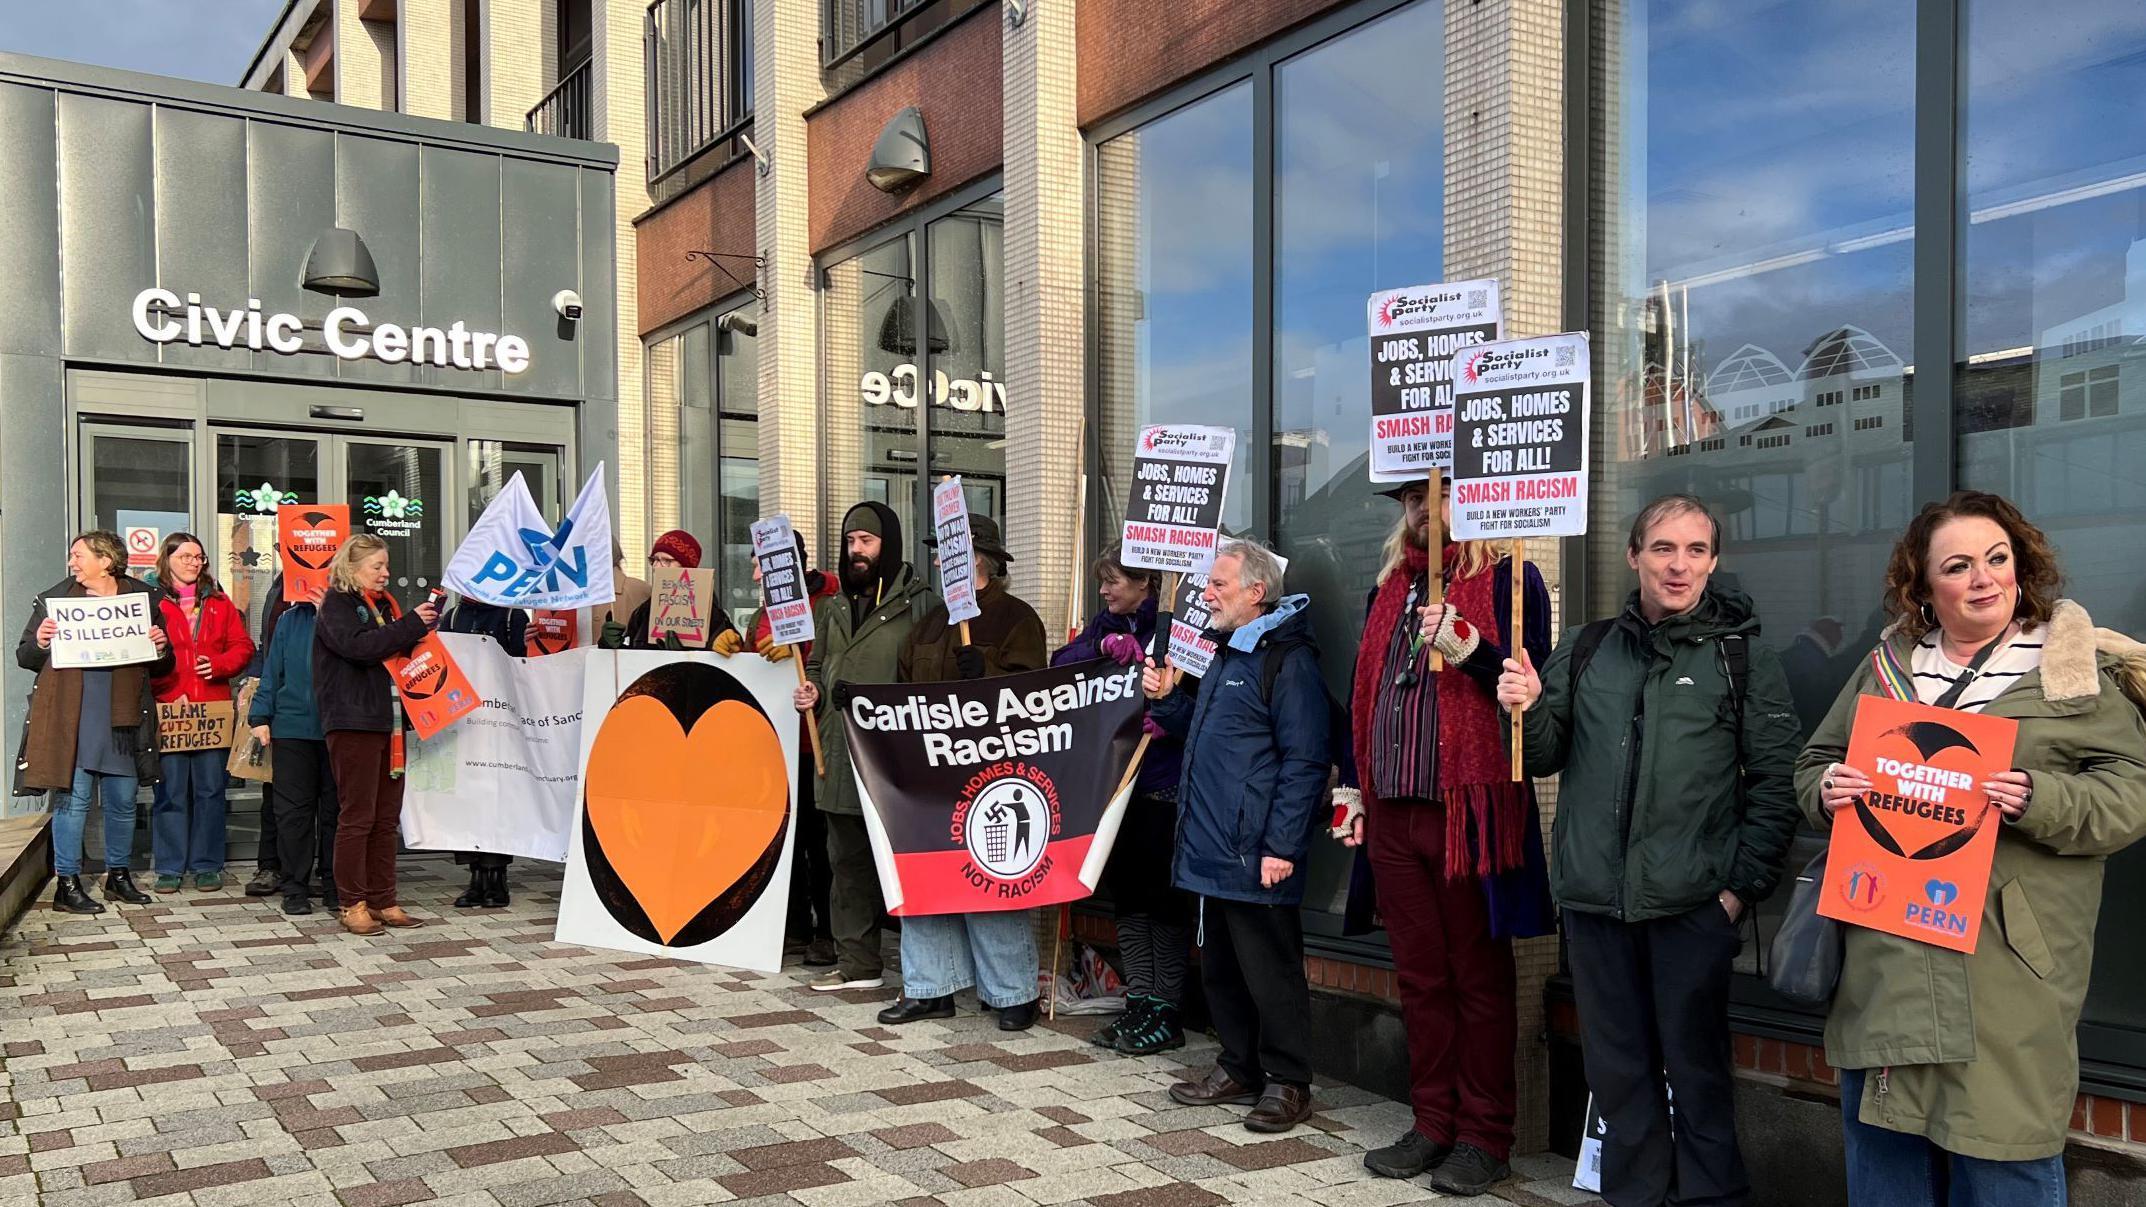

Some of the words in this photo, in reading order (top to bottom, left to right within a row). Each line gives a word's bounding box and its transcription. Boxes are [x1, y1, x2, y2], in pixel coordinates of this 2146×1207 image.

[1396, 293, 1462, 307] Socialist
[133, 287, 303, 352] Civic
[323, 307, 529, 374] Centre
[1378, 338, 1423, 362] JOBS,
[1482, 348, 1549, 363] Socialist
[1389, 367, 1401, 386] &
[1405, 359, 1455, 385] SERVIC
[1401, 387, 1431, 410] FOR
[1435, 384, 1452, 406] AL
[1461, 396, 1507, 422] JOBS,
[1511, 390, 1571, 418] HOMES
[1160, 430, 1207, 441] Socialist
[1377, 416, 1430, 439] SMASH
[1471, 427, 1483, 448] &
[1487, 418, 1563, 447] SERVICES
[1388, 444, 1405, 453] BUILD
[1407, 443, 1411, 452] A
[1413, 442, 1428, 451] NEW
[1430, 440, 1451, 450] WORKE
[1402, 453, 1419, 462] FIGHT
[1422, 452, 1434, 460] FOR
[1482, 450, 1513, 474] FOR
[1516, 446, 1551, 471] ALL!
[1138, 462, 1171, 483] JOBS,
[1174, 465, 1217, 485] HOMES
[1143, 485, 1152, 500] &
[1154, 484, 1209, 505] SERVICES
[1457, 480, 1510, 504] SMASH
[1516, 477, 1577, 501] RACISM
[366, 518, 421, 529] Cumberland
[1147, 503, 1170, 522] FOR
[1171, 505, 1198, 524] ALL!
[1466, 510, 1484, 521] BUILD
[1486, 510, 1490, 519] A
[1492, 509, 1507, 519] NEW
[1544, 506, 1566, 516] PARTY
[292, 529, 337, 538] TOGETHER
[377, 528, 411, 537] Council
[1480, 520, 1498, 530] FIGHT
[1500, 520, 1512, 529] FOR
[1514, 518, 1551, 529] SOCIALISM
[303, 537, 327, 545] WITH
[1126, 525, 1166, 544] SMASH
[1169, 529, 1214, 548] RACISM
[294, 544, 337, 552] REFUGEES
[1150, 548, 1161, 556] NEW
[1188, 551, 1204, 560] PARTY
[1155, 557, 1165, 565] FOR
[1165, 558, 1192, 567] SOCIALISM
[1187, 572, 1209, 589] JOB
[1185, 590, 1196, 604] &
[56, 603, 143, 622] NO-ONE
[655, 616, 664, 626] ON
[666, 617, 680, 627] OUR
[1184, 607, 1207, 627] FOR
[58, 628, 72, 641] IS
[77, 624, 146, 640] ILLEGAL
[1170, 623, 1196, 645] MASH
[405, 663, 441, 690] REFUGEES
[852, 694, 989, 732] Carlisle
[995, 665, 1139, 725] Against
[162, 703, 207, 719] BLAME
[159, 720, 192, 733] CUTS
[197, 717, 225, 731] NOT
[520, 716, 535, 727] ace
[538, 716, 550, 727] of
[160, 731, 222, 749] REFUGEES
[922, 722, 1073, 767] Racism
[1876, 757, 1973, 791] TOGETHER
[1896, 778, 1947, 803] WITH
[950, 795, 972, 845] JOBS,
[964, 761, 1014, 798] HOMES
[1016, 762, 1026, 776] &
[1027, 766, 1062, 836] SERVICES
[1869, 791, 1966, 825] REFUGEES
[960, 861, 995, 894] NOT
[998, 855, 1054, 899] RACISM
[1905, 902, 1968, 933] PERN
